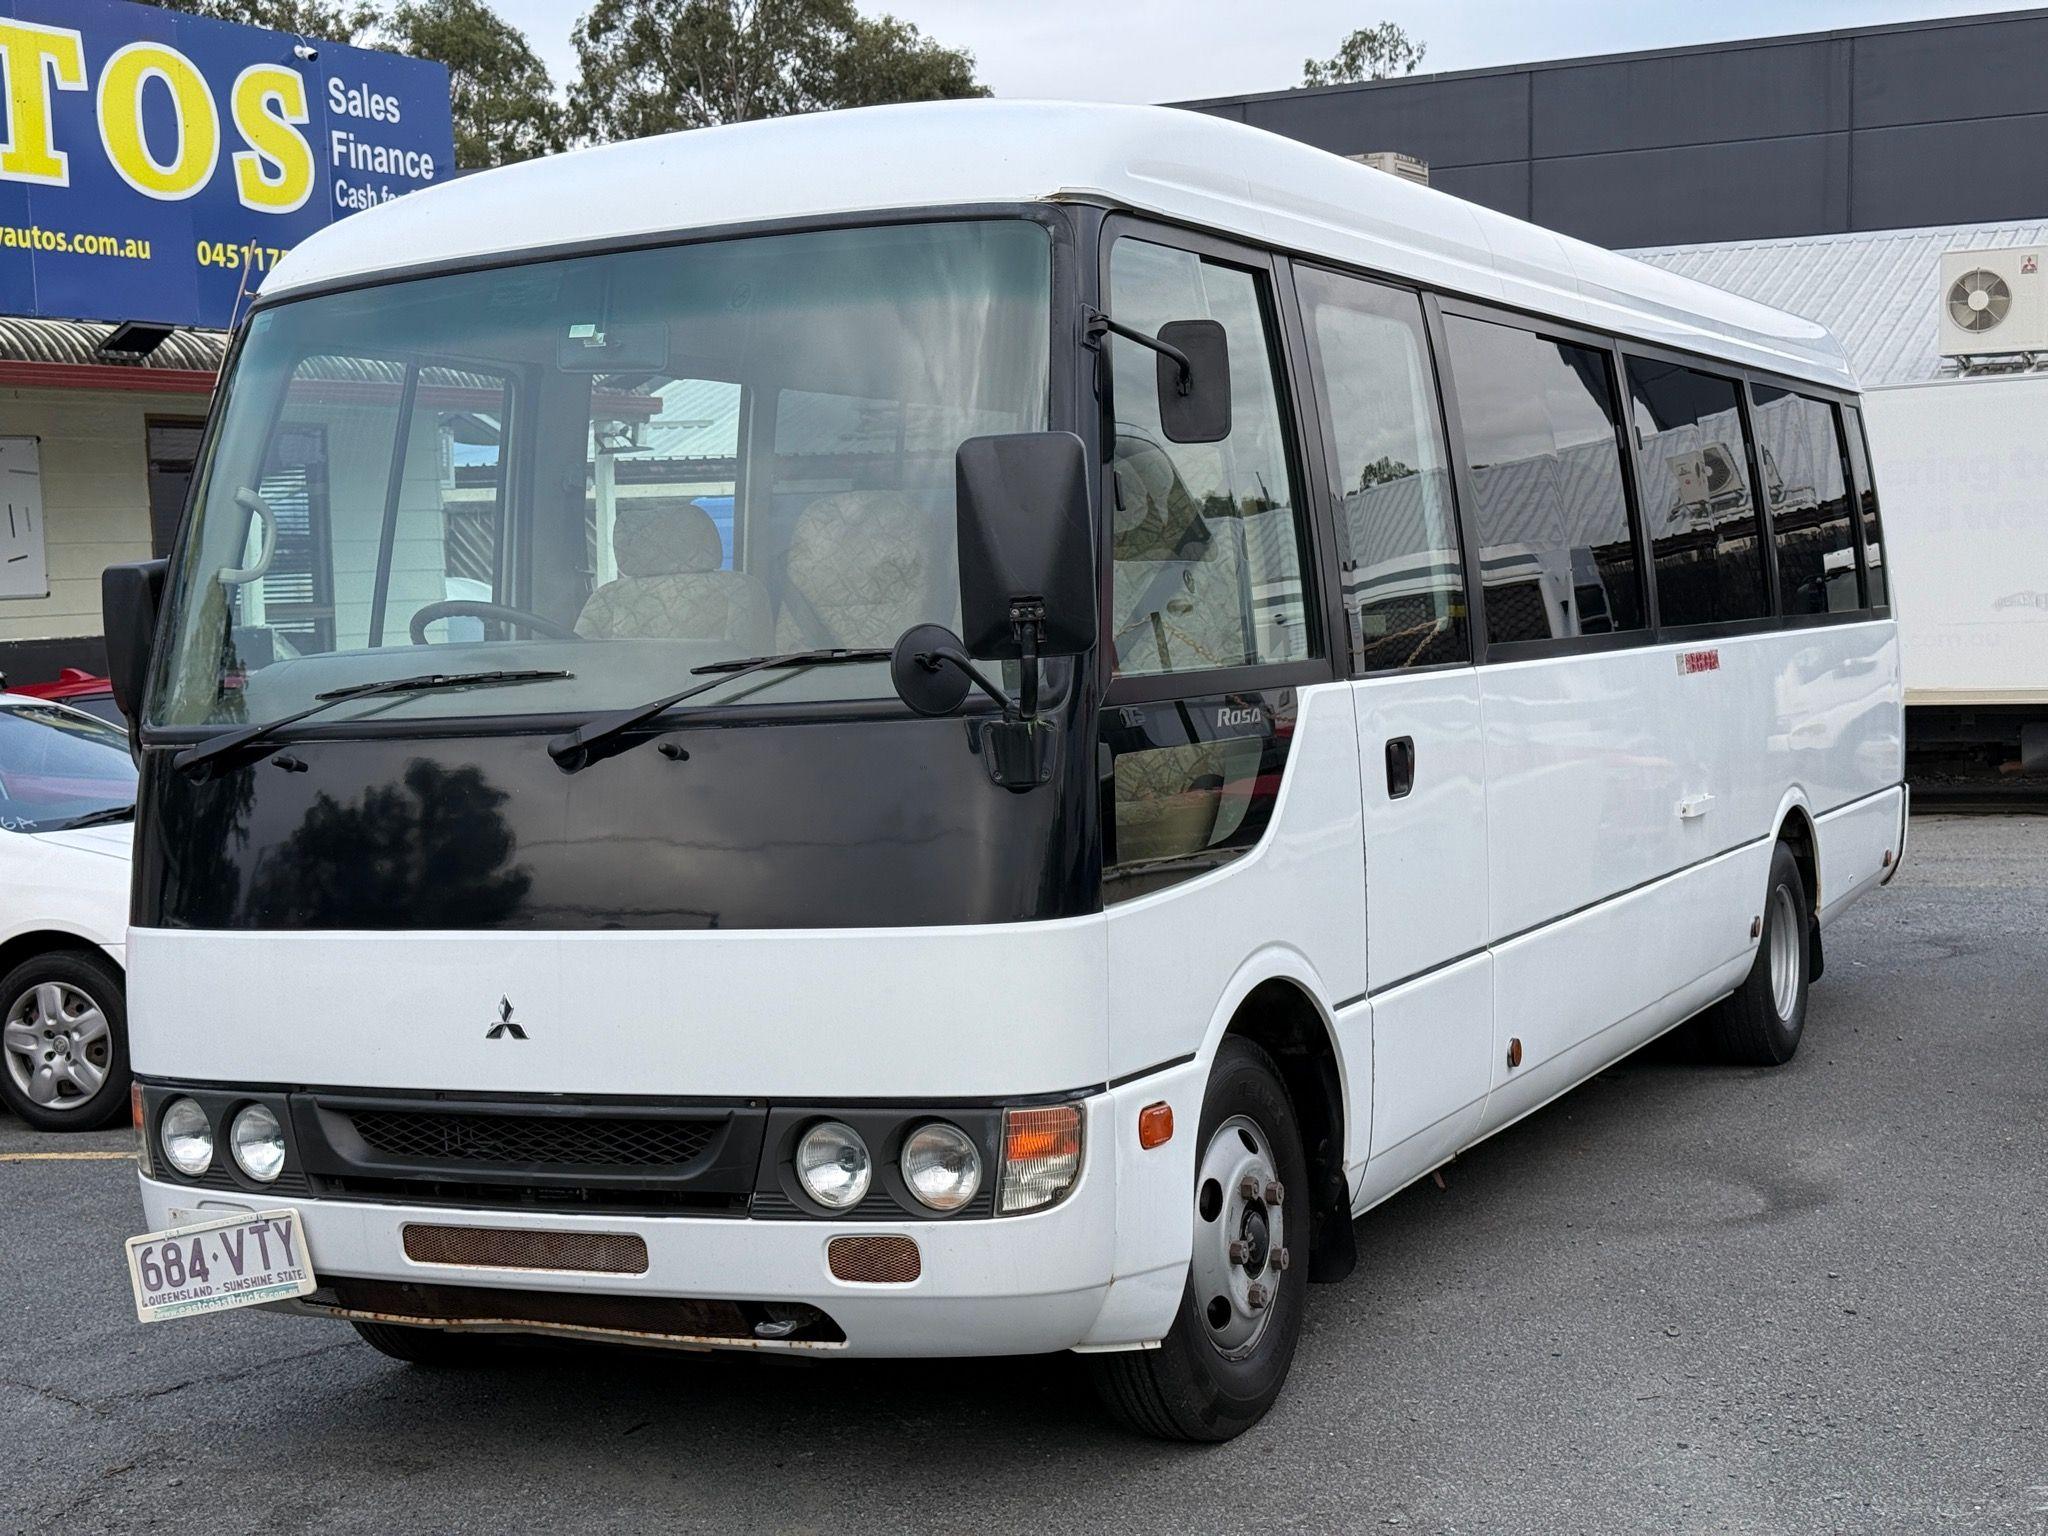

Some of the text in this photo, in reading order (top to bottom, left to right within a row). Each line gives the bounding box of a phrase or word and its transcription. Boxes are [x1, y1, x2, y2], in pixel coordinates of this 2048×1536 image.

[328, 77, 401, 124] Sales
[331, 130, 435, 180] Finance
[335, 179, 378, 209] Cash
[150, 1285, 213, 1306] QUEENSLAND
[223, 1273, 273, 1292] SUNSHINE
[277, 1270, 303, 1283] STATE
